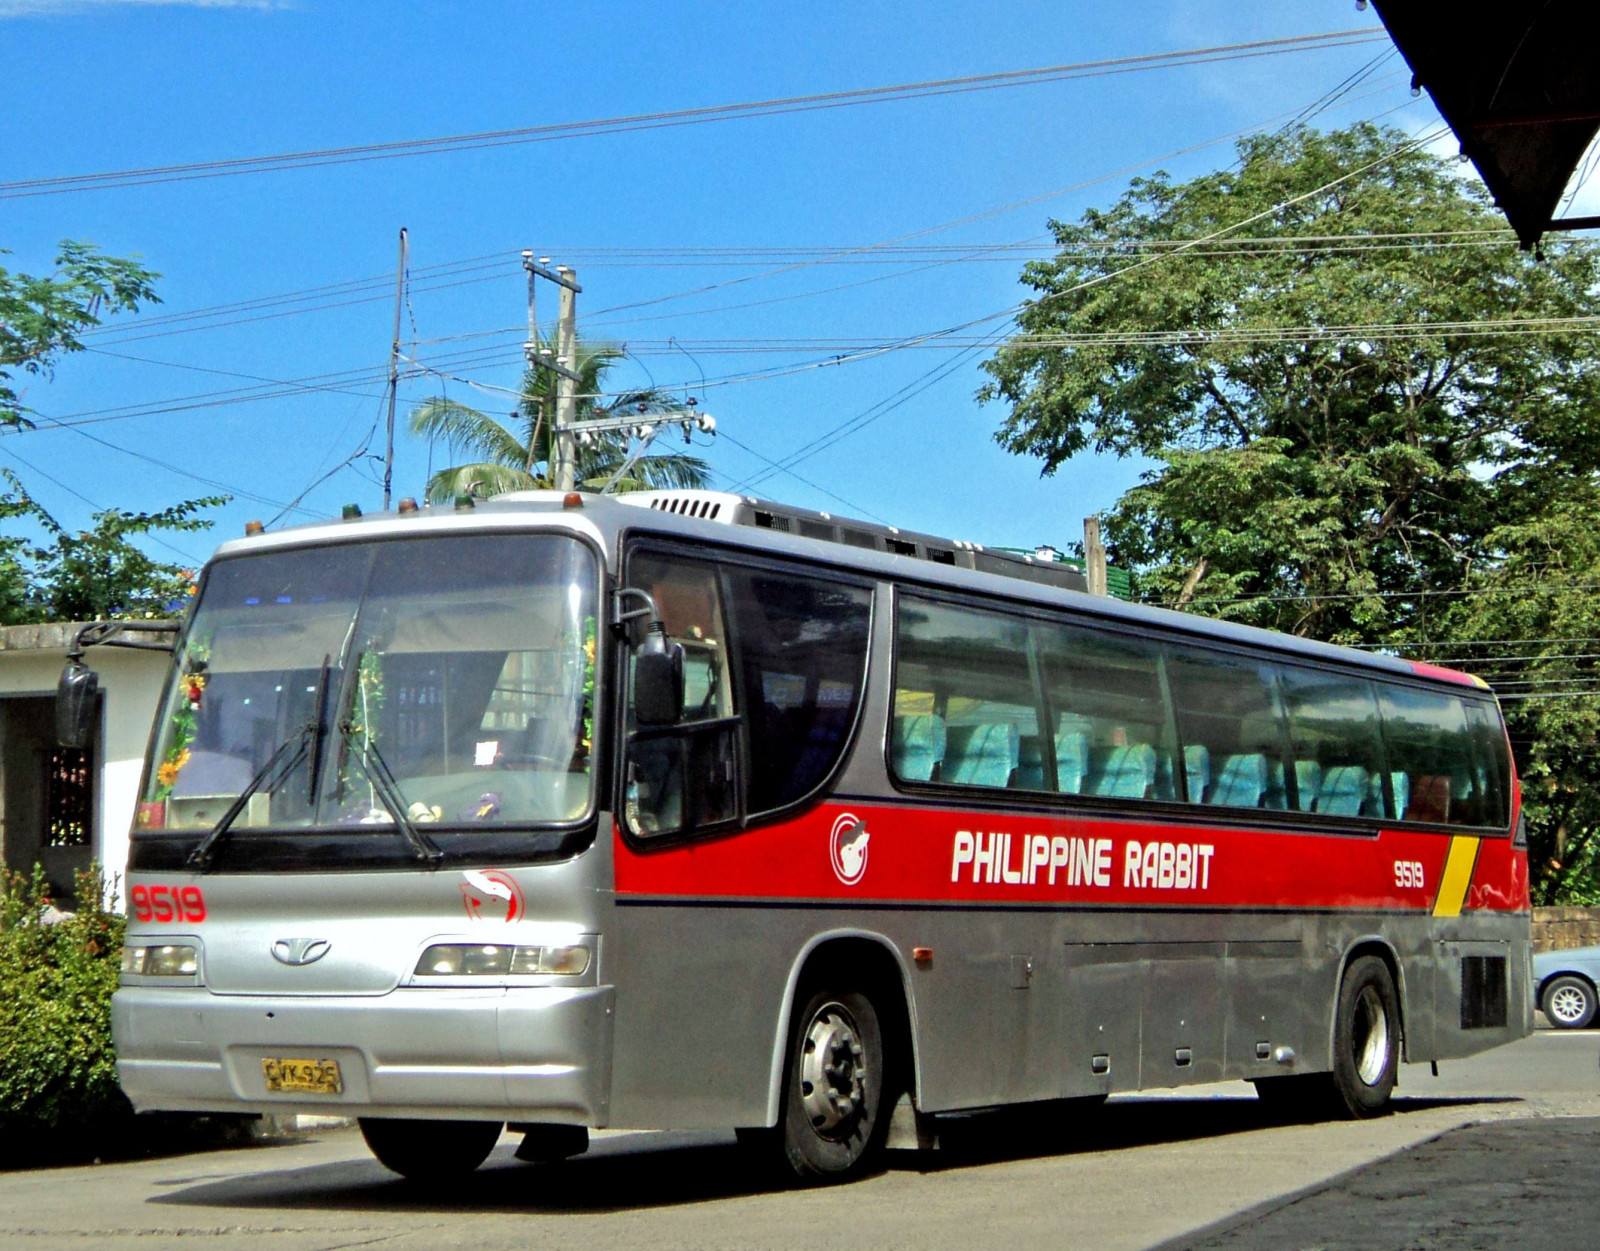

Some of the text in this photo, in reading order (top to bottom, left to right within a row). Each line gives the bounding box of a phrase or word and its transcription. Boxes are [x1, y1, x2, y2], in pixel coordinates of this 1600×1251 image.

[951, 831, 1214, 889] PHILIPPINE RABBIT
[1394, 860, 1424, 888] 9519
[131, 885, 207, 924] 9519
